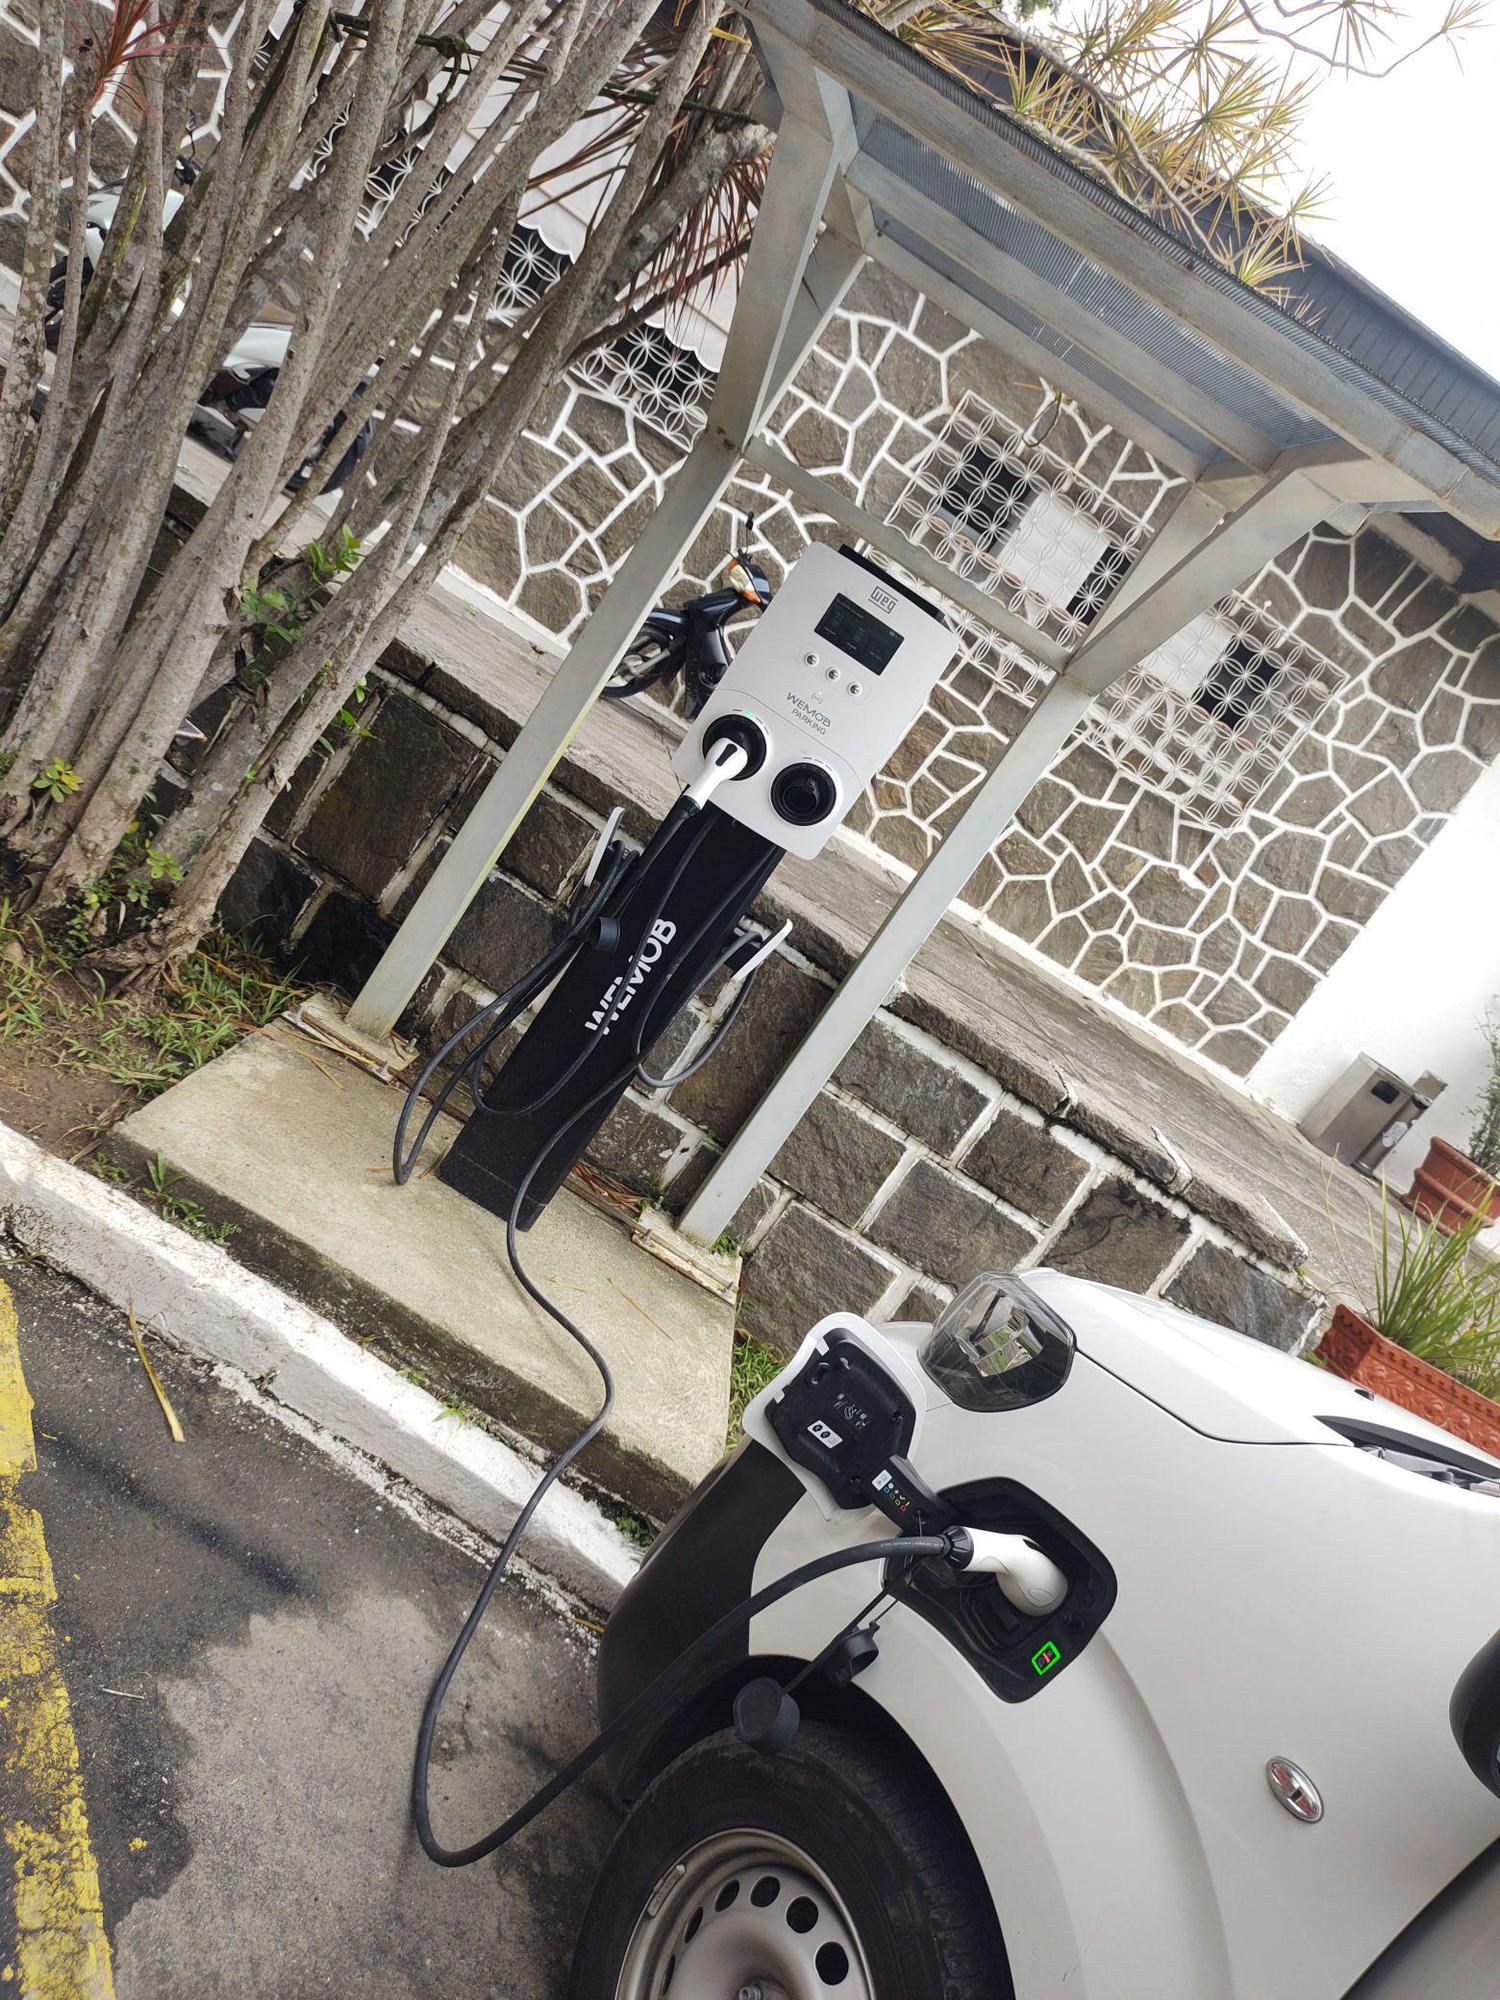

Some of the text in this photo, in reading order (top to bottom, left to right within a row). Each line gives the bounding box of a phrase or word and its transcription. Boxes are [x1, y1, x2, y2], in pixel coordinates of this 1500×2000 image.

[787, 692, 830, 727] WEMOB
[791, 708, 826, 735] PARKING
[584, 919, 677, 1035] WEMOB
